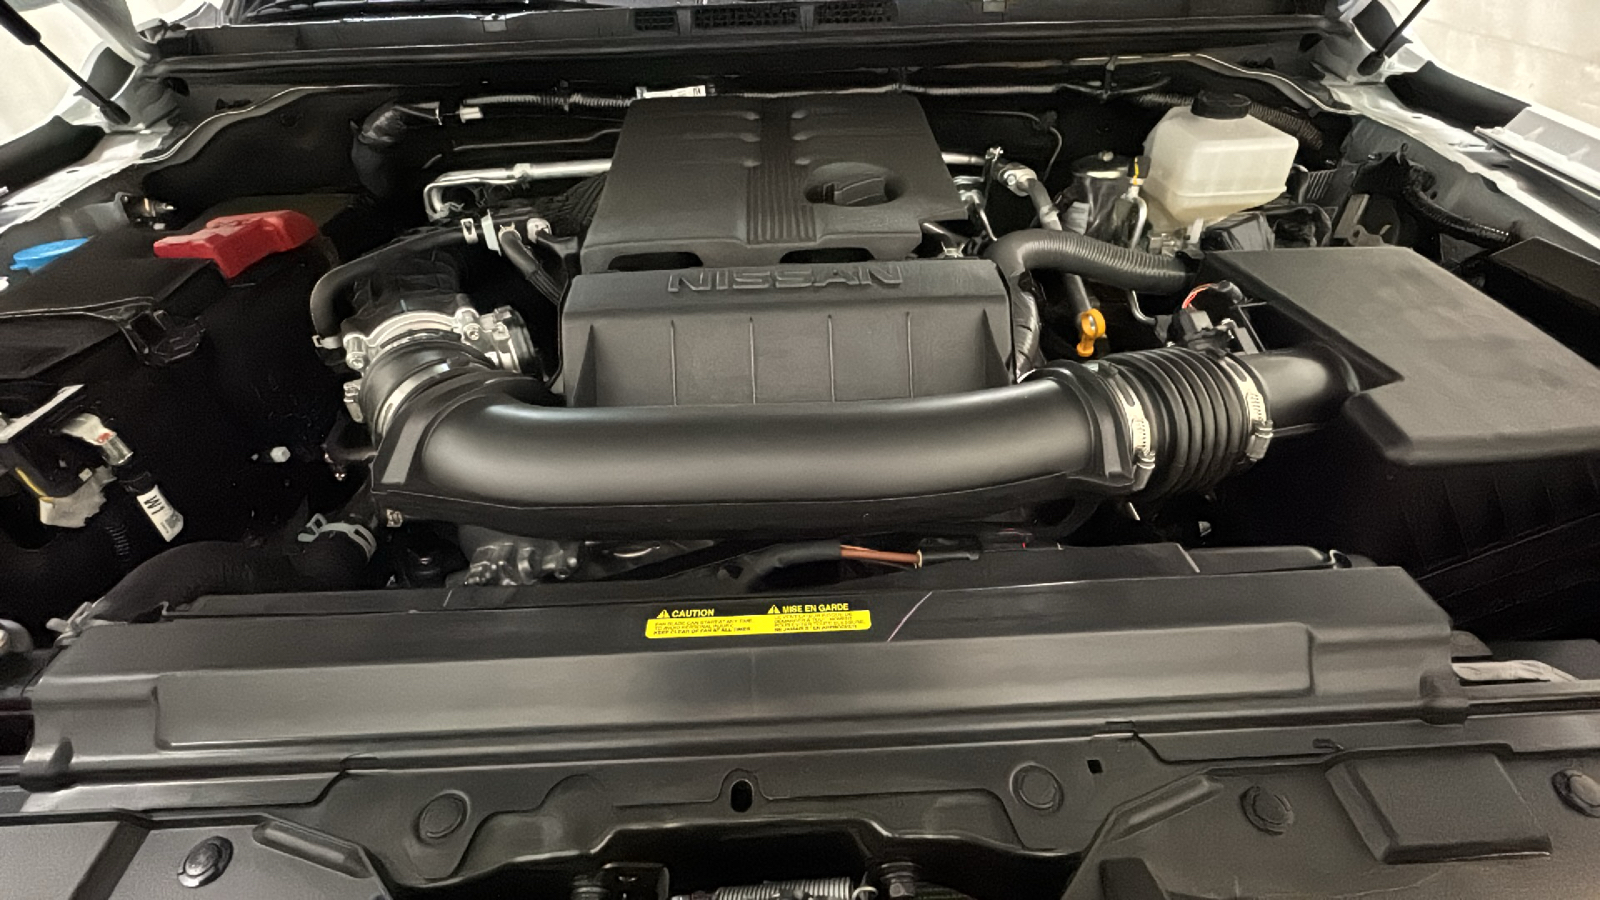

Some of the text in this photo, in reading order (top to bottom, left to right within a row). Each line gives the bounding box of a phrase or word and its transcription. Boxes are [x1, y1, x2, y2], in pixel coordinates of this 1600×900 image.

[667, 265, 903, 292] NISSAN
[671, 608, 714, 618] CAUTION
[782, 603, 849, 614] MISE EN GARDE
